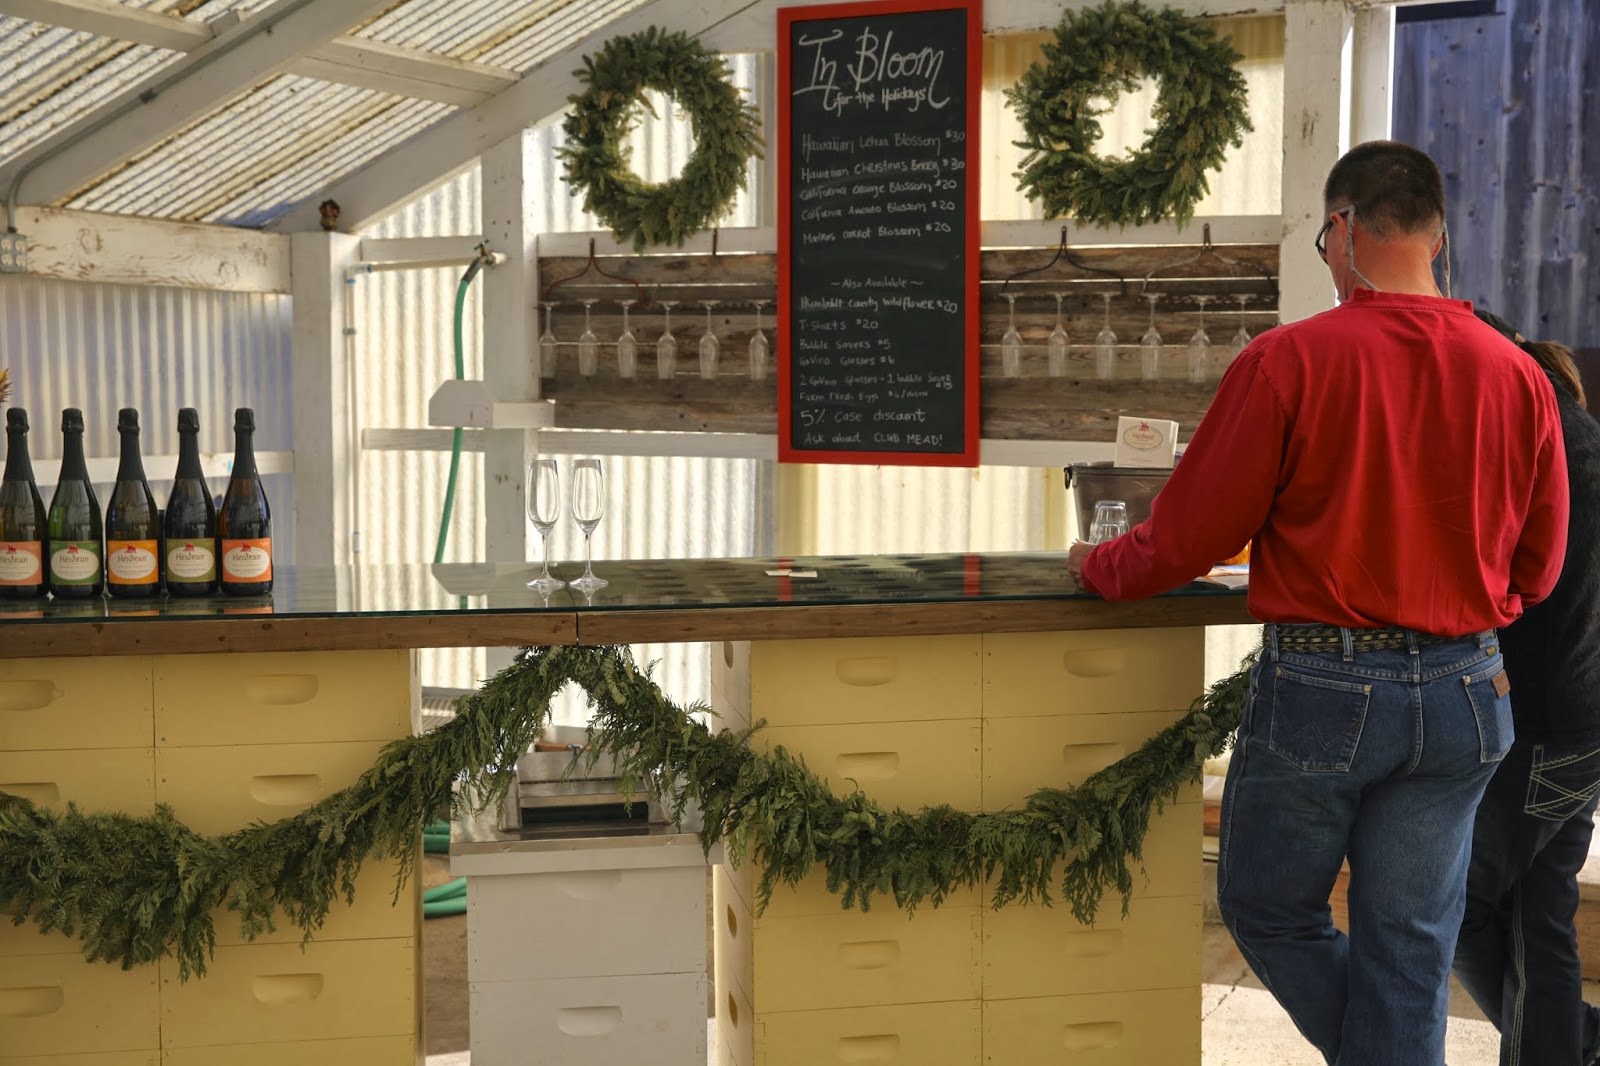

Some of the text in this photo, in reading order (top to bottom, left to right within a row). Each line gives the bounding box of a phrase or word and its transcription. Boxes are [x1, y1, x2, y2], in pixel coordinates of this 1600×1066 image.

[792, 26, 950, 111] In Bloom
[834, 87, 926, 117] for the Holidays
[894, 133, 941, 156] Blossom
[946, 130, 965, 142] $30
[889, 181, 932, 193] Blossom
[935, 179, 957, 189] $20
[887, 202, 926, 212] Blossom
[932, 200, 955, 210] $20
[878, 226, 920, 237] Blossom
[926, 222, 951, 232] $20
[842, 276, 907, 289] Also Available
[936, 299, 958, 313] $20
[856, 318, 878, 329] $20
[878, 339, 891, 349] $5
[800, 408, 826, 426] 5%
[804, 432, 824, 444] Ask
[832, 432, 862, 443] about
[117, 554, 147, 563] Heidrun
[176, 552, 205, 561] Heidrun
